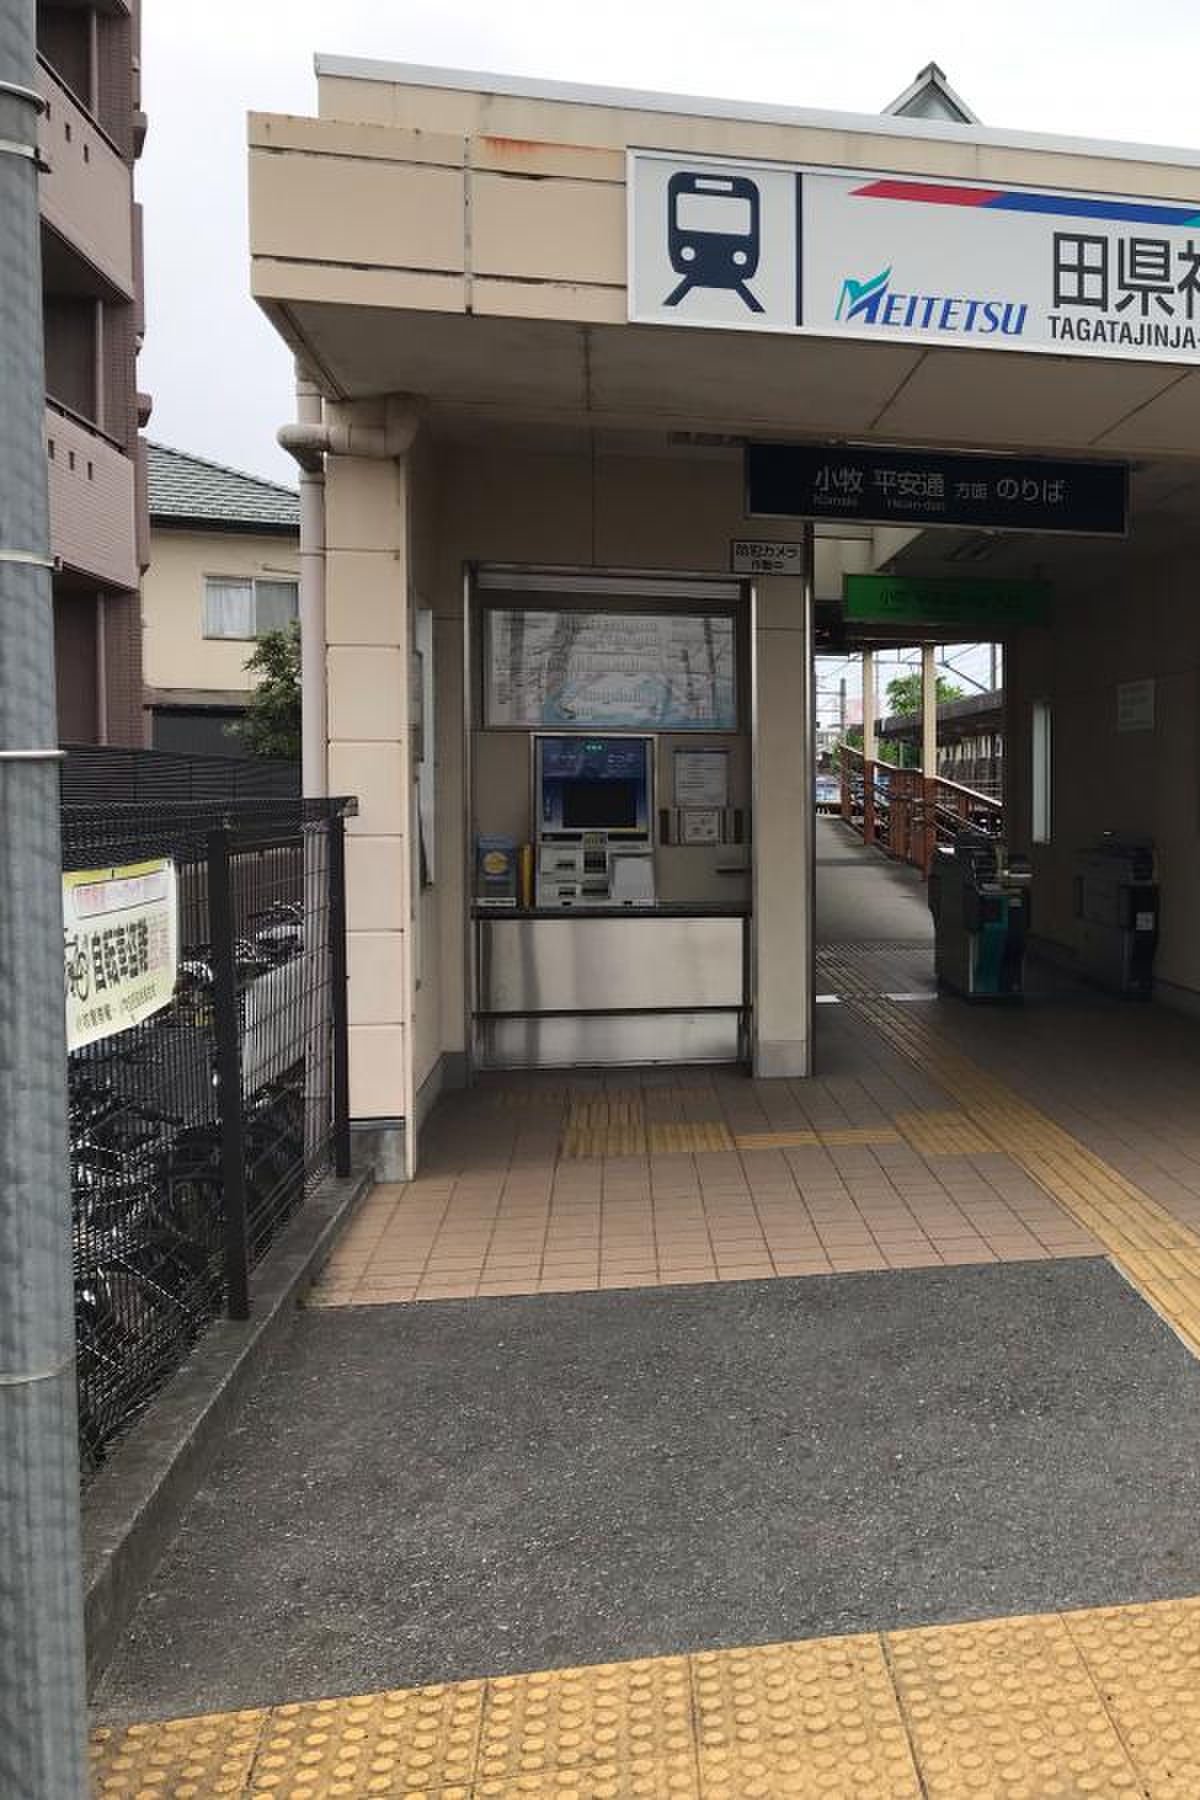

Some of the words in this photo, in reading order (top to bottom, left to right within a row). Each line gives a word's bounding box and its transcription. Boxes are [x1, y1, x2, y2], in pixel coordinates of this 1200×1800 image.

[834, 265, 1028, 337] MEITETSU
[996, 478, 1065, 502] のりば
